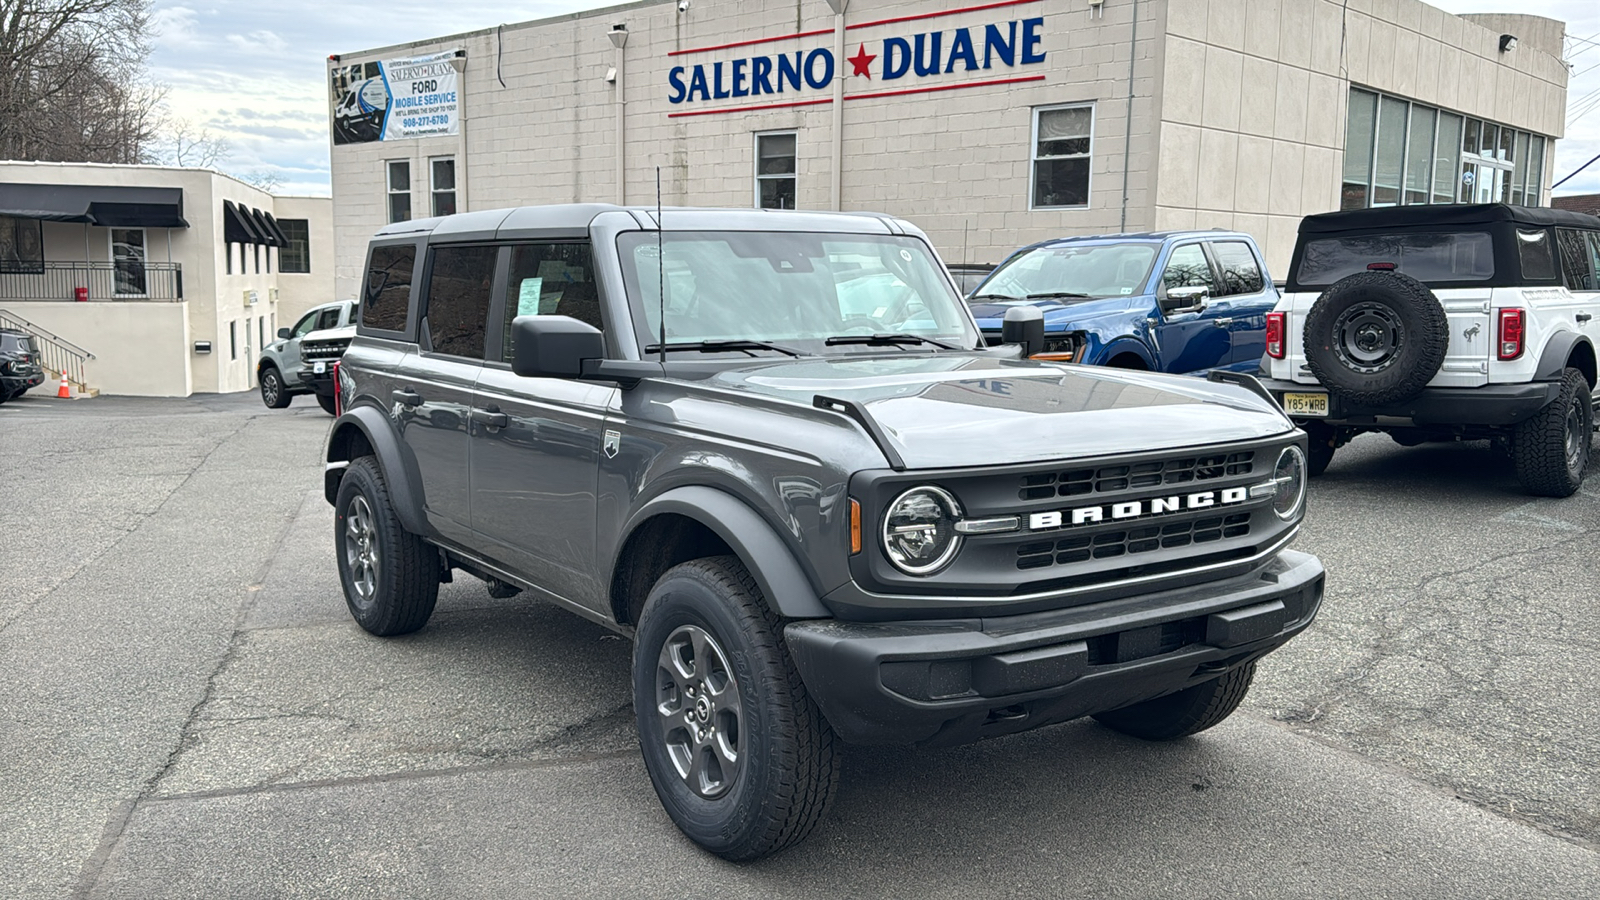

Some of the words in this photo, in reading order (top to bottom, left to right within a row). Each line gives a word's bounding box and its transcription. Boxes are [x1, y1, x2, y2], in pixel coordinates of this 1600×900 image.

[668, 48, 835, 104] SALERNO
[882, 17, 1048, 81] DUANE
[390, 66, 424, 81] SALERNO
[412, 80, 437, 95] FORD
[395, 96, 423, 109] MOBILE
[424, 92, 456, 105] SERVICE
[403, 114, 449, 128] 908-277-6780
[1287, 399, 1304, 410] Y85
[1309, 399, 1326, 411] WRB
[1030, 487, 1247, 529] BRONCO
